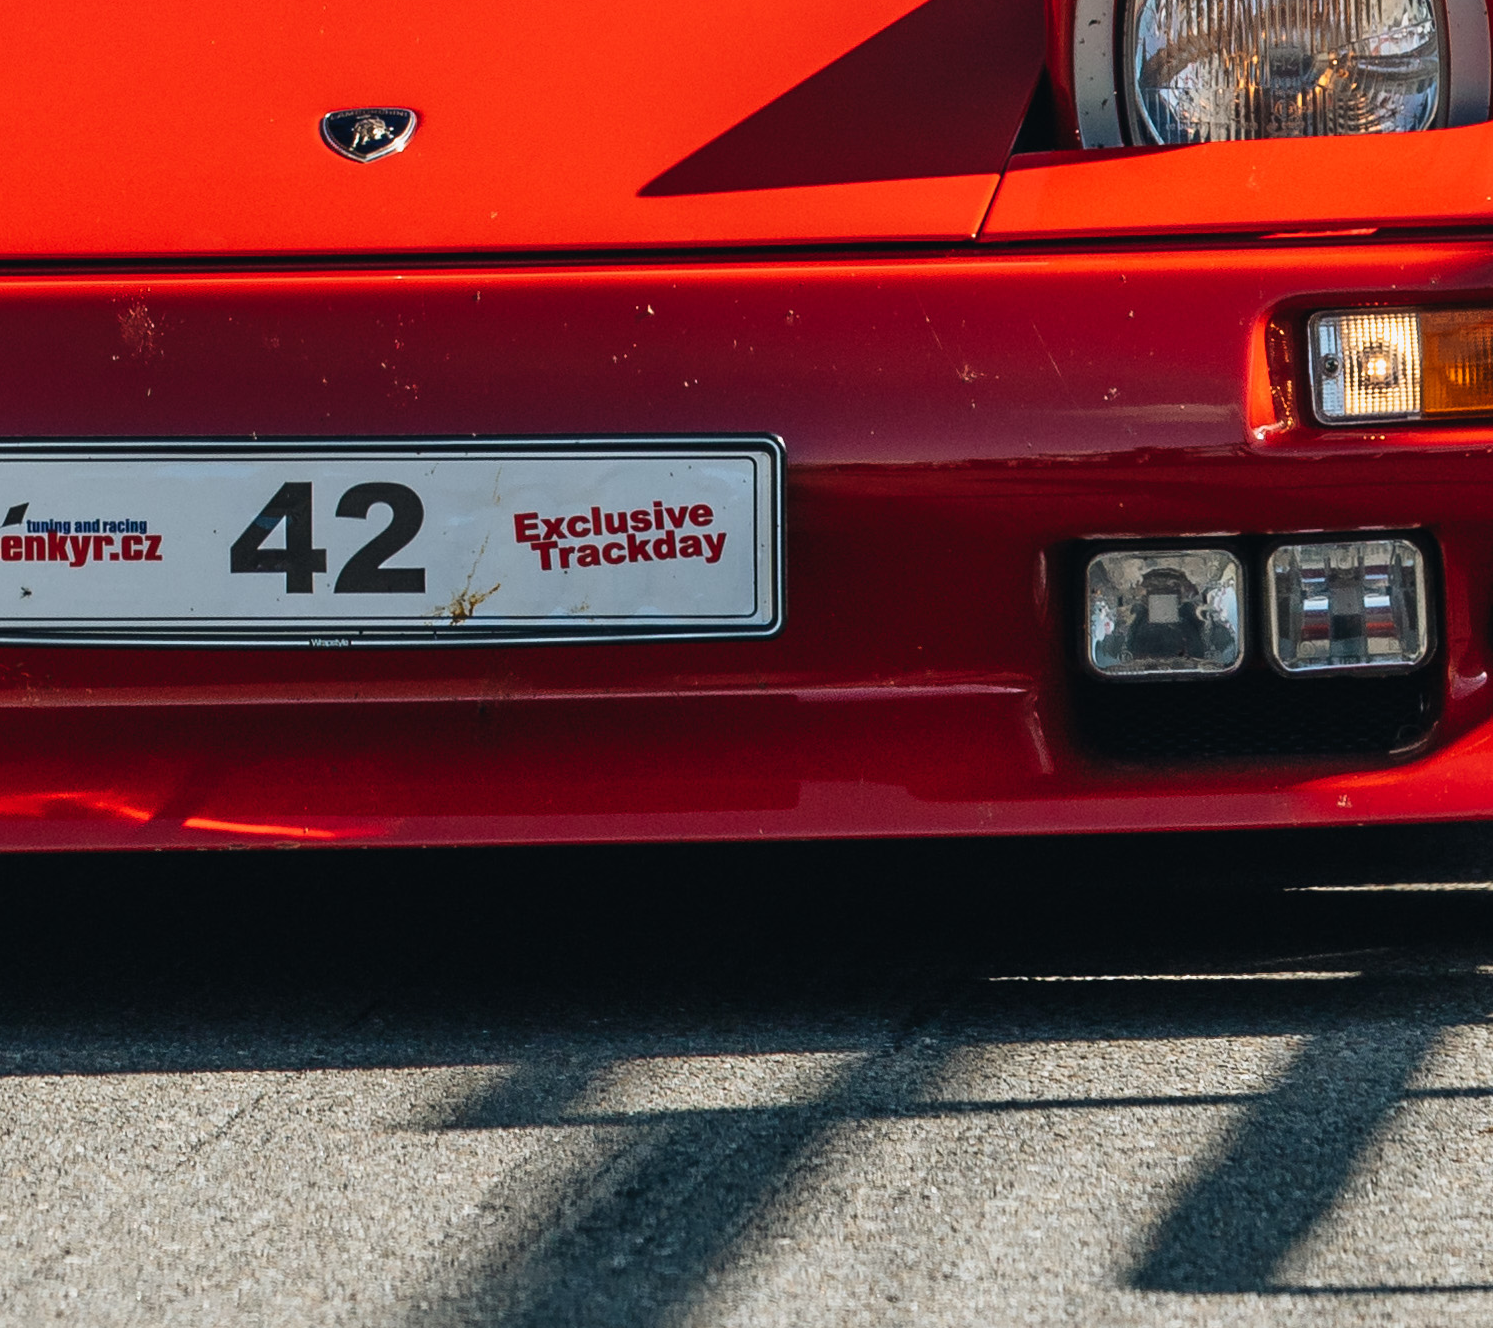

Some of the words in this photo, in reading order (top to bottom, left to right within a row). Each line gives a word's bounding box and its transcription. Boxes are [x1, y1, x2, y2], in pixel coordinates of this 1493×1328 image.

[26, 518, 71, 534] tuning
[74, 518, 100, 534] and
[102, 518, 148, 534] racing
[230, 481, 426, 594] 42
[514, 500, 714, 544] Exclusive
[530, 529, 727, 571] Trackday
